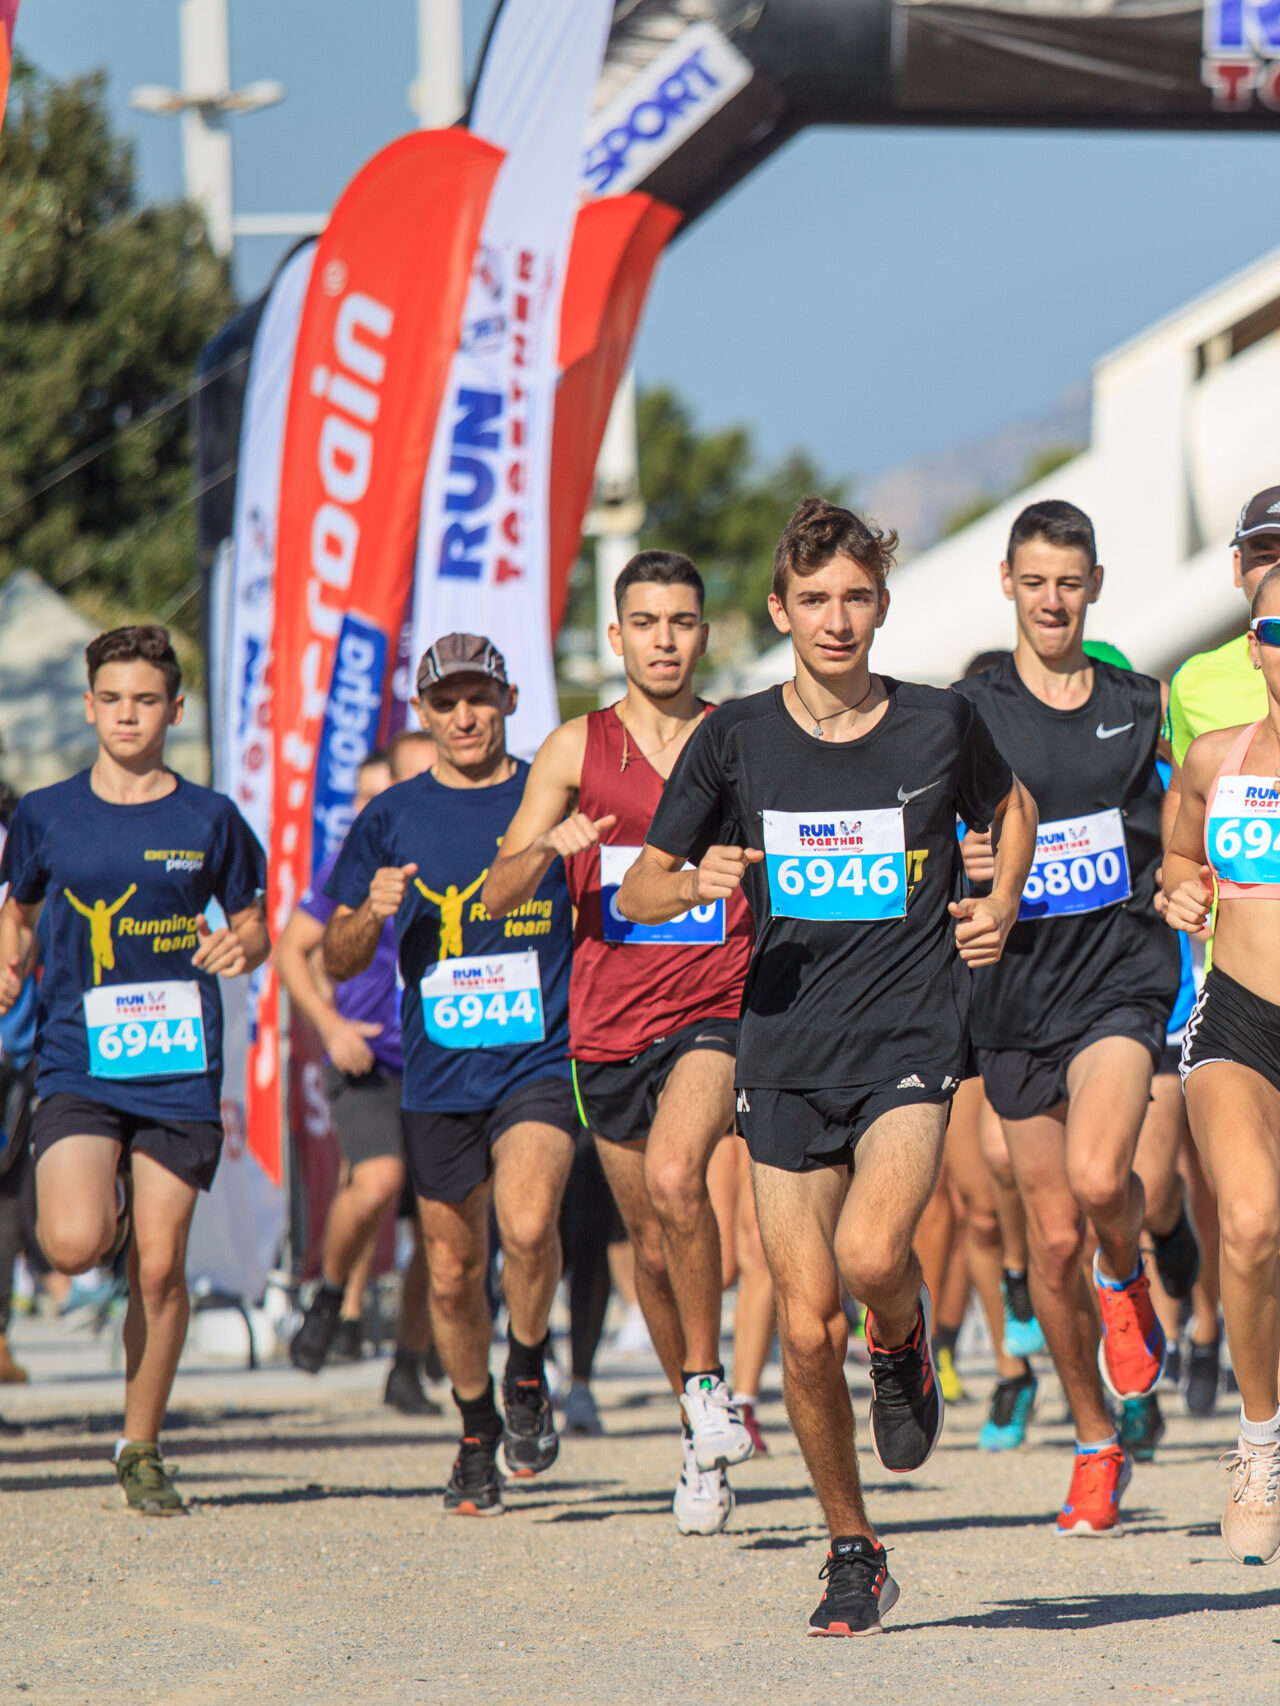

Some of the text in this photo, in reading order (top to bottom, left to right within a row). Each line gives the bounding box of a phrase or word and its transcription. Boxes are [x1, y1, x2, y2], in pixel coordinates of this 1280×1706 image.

[439, 388, 505, 580] RUN
[1246, 786, 1280, 800] RUN
[799, 824, 835, 837] RUN
[1037, 832, 1065, 845] RUN
[800, 837, 863, 846] TOGETHER
[778, 855, 898, 896] 6946
[1021, 851, 1120, 899] 6800
[469, 898, 552, 923] Rning
[118, 913, 199, 937] Running
[504, 919, 551, 938] team
[152, 933, 197, 954] team
[453, 968, 482, 980] RUN
[116, 994, 144, 1006] RUN
[433, 990, 536, 1029] 6944
[98, 1018, 198, 1060] 6944
